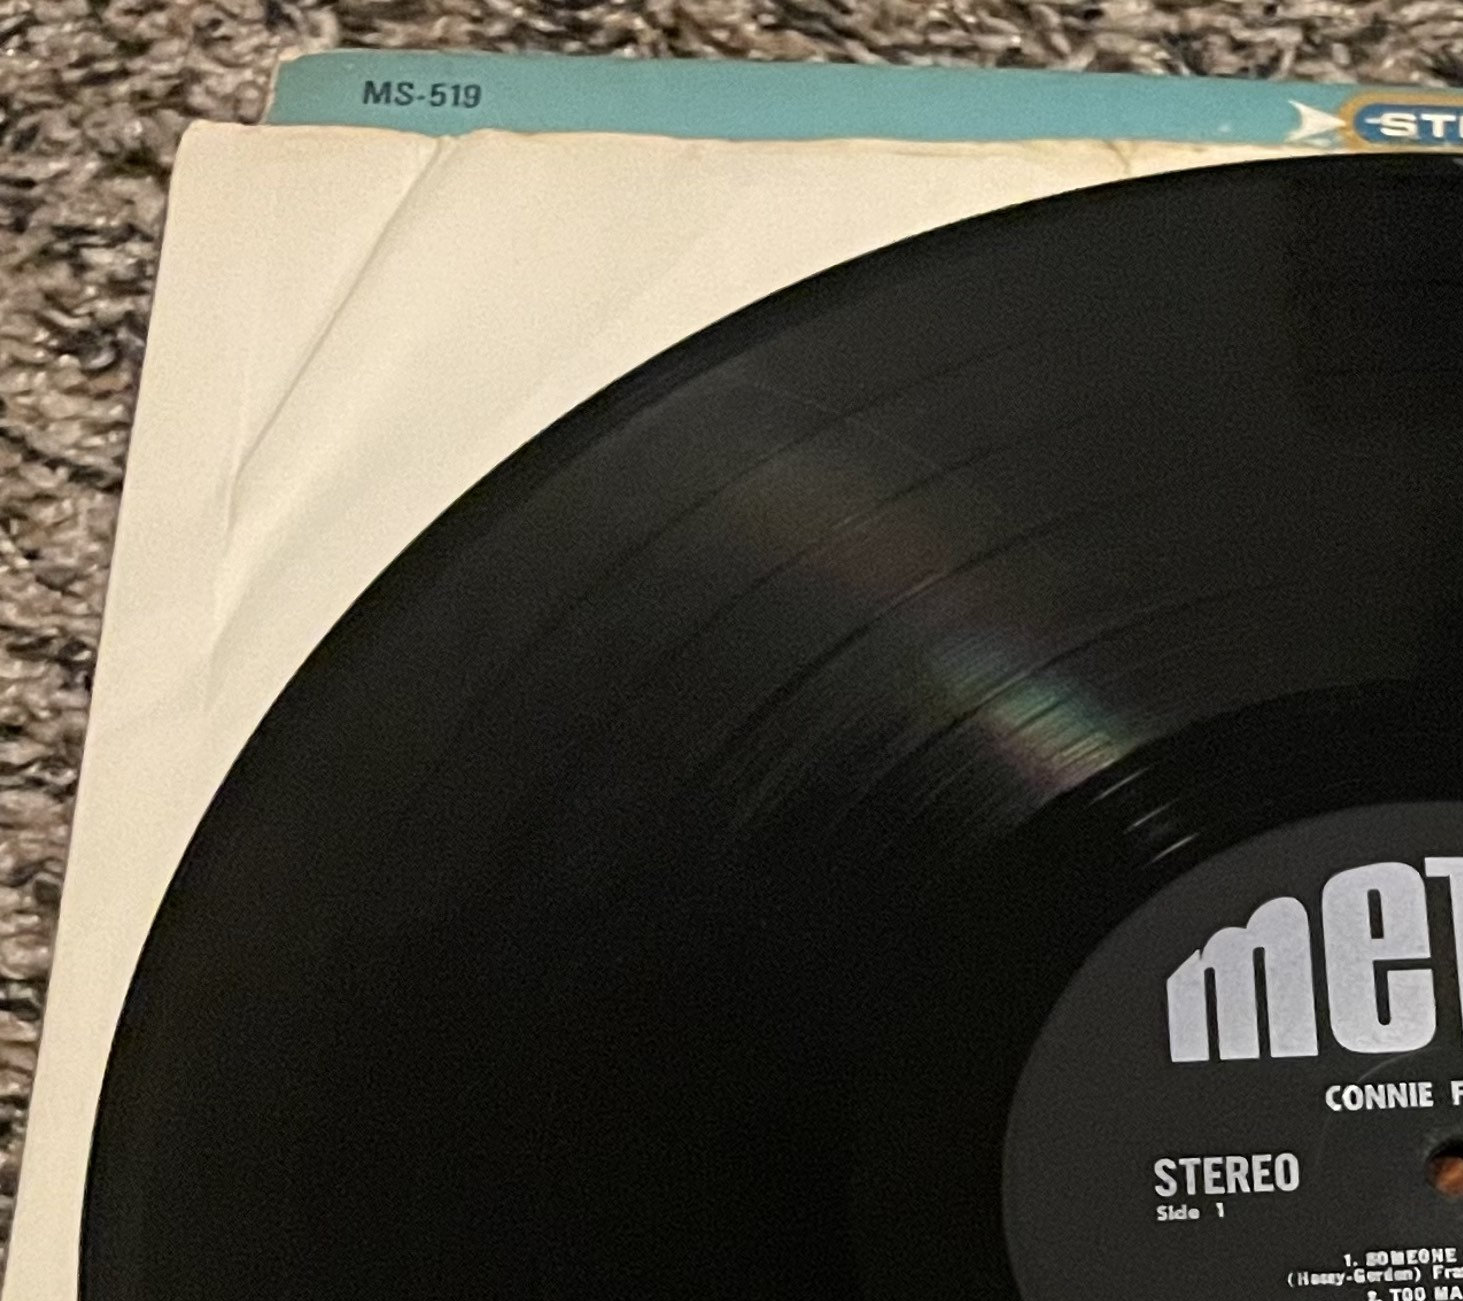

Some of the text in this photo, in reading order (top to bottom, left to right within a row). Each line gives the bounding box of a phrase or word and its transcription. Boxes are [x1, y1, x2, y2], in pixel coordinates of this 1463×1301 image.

[362, 80, 482, 110] MS-519
[1325, 1081, 1434, 1112] CONNIE
[1154, 1152, 1300, 1198] STEREO
[1156, 1202, 1225, 1221] Side 1
[1344, 1253, 1358, 1268] 1.
[1366, 1247, 1457, 1268] SOMEONE
